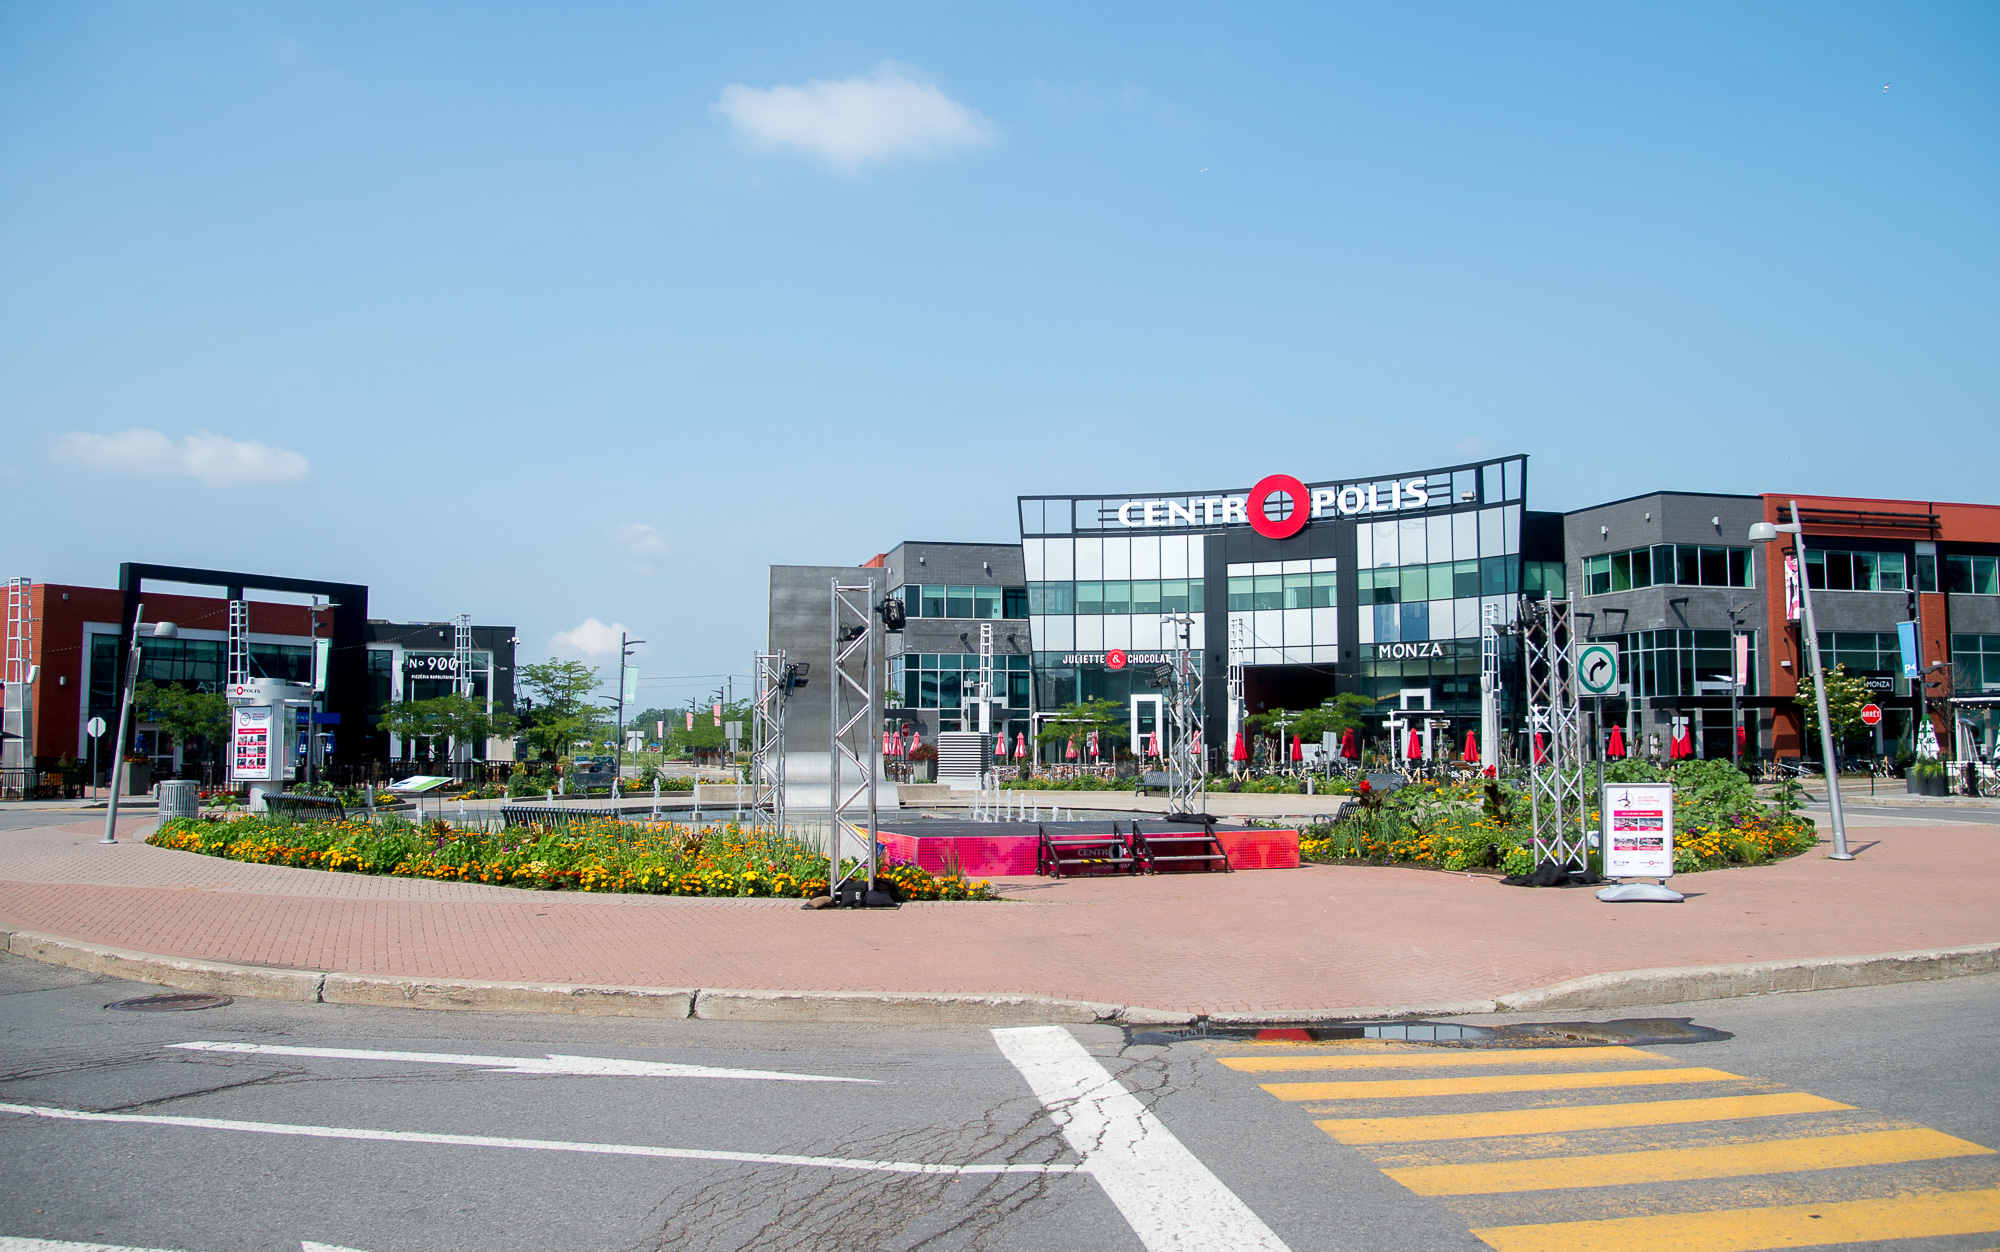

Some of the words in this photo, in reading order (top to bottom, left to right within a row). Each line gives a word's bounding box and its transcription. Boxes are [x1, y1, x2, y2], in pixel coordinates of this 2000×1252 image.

[1118, 474, 1429, 539] CENTROPOLIS
[1378, 642, 1443, 659] MONZA
[1062, 654, 1105, 664] JULIETTE
[1127, 654, 1169, 664] CHOCOLAT
[1904, 664, 1917, 674] P4
[1862, 710, 1880, 718] ARRÊT
